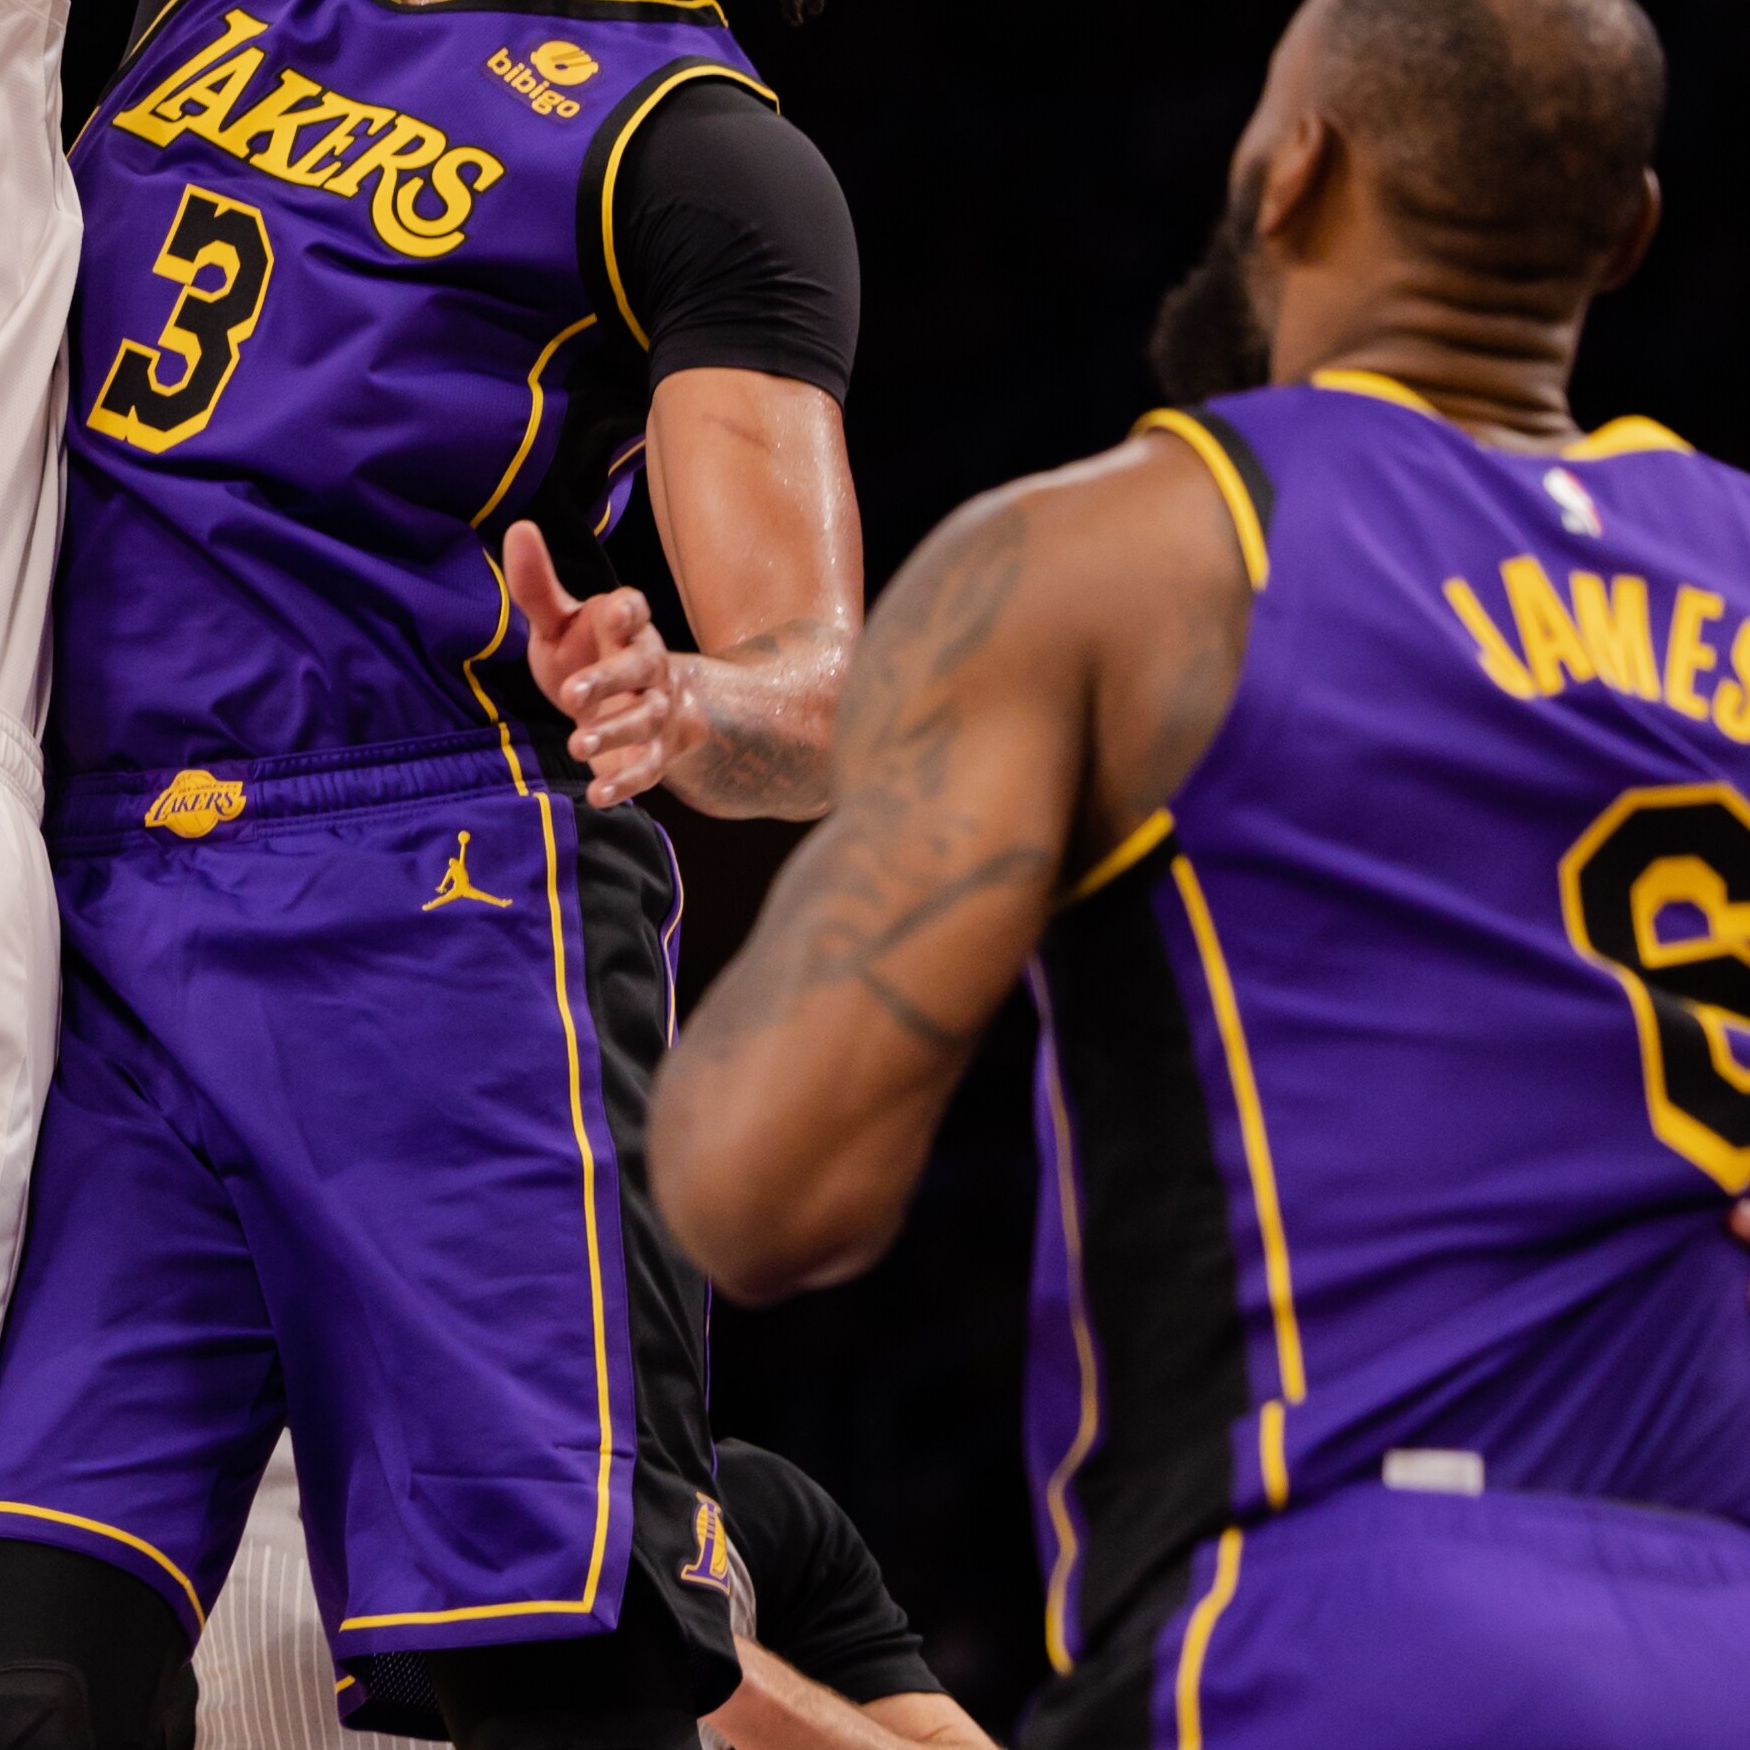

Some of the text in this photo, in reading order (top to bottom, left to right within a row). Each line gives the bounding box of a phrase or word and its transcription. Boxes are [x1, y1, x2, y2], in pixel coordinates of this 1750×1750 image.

[112, 8, 506, 259] LAKERS
[487, 47, 581, 119] bibigo
[86, 183, 276, 454] 3
[152, 790, 234, 822] LAKERS
